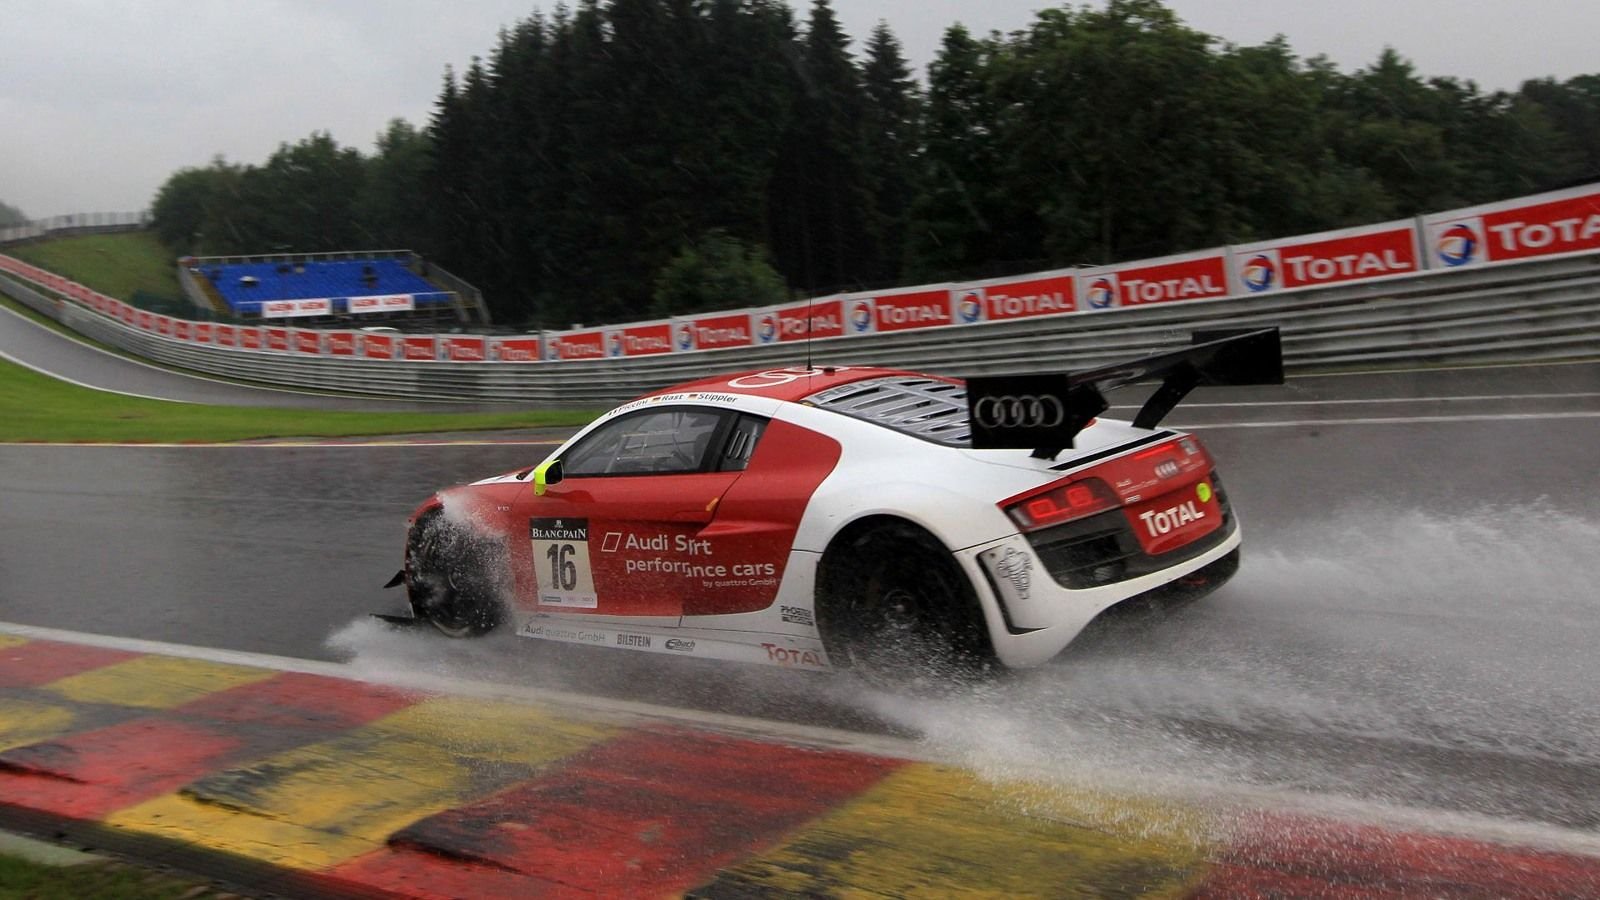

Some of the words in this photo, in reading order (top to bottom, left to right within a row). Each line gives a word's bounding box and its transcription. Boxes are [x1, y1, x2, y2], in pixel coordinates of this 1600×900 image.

[1284, 250, 1411, 281] TOTAL
[1122, 275, 1222, 302] TOTAL
[990, 293, 1071, 315] TOTAL
[879, 305, 948, 324] TOTAL
[781, 315, 841, 334] TOTAL
[624, 335, 671, 351] TOTAL
[698, 327, 749, 343] TOTAL
[698, 393, 738, 404] Stippler
[1139, 500, 1205, 537] TOTAL
[532, 528, 587, 539] BLANCPAIN
[625, 533, 669, 551] Audi
[675, 534, 713, 555] Srt
[546, 543, 577, 591] 16
[625, 557, 727, 579] perfornce
[732, 562, 776, 577] cars
[703, 580, 713, 588] by
[714, 579, 747, 588] quattro
[748, 578, 777, 586] GmbH
[525, 625, 544, 635] Audi
[616, 633, 651, 648] BILSTEIN
[664, 638, 697, 651] Eibach
[761, 643, 824, 666] TOTAL
